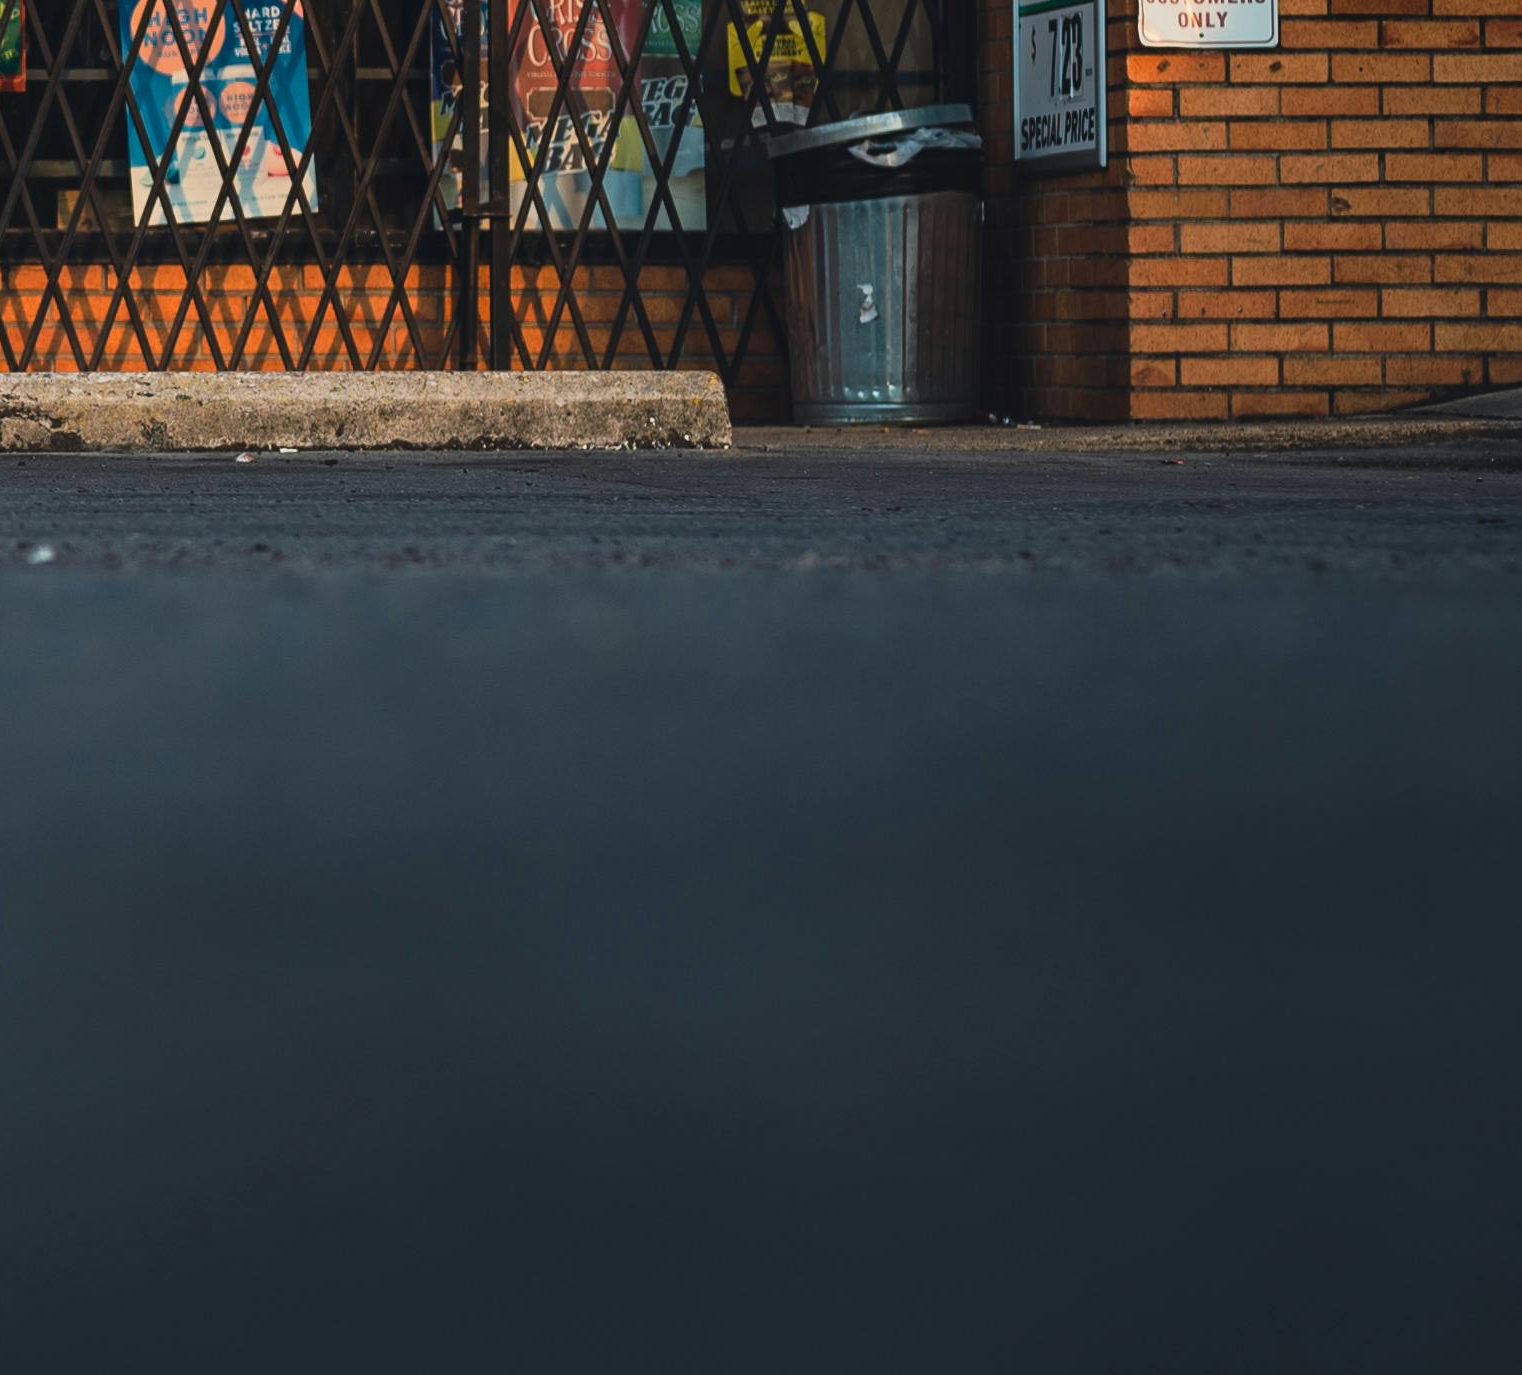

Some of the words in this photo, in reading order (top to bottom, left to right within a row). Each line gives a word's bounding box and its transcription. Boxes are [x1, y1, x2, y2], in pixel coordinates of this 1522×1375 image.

[146, 7, 208, 28] HGH
[1178, 12, 1228, 29] ONLY
[1021, 111, 1062, 151] SPECIAL
[1064, 107, 1095, 145] PRICE
